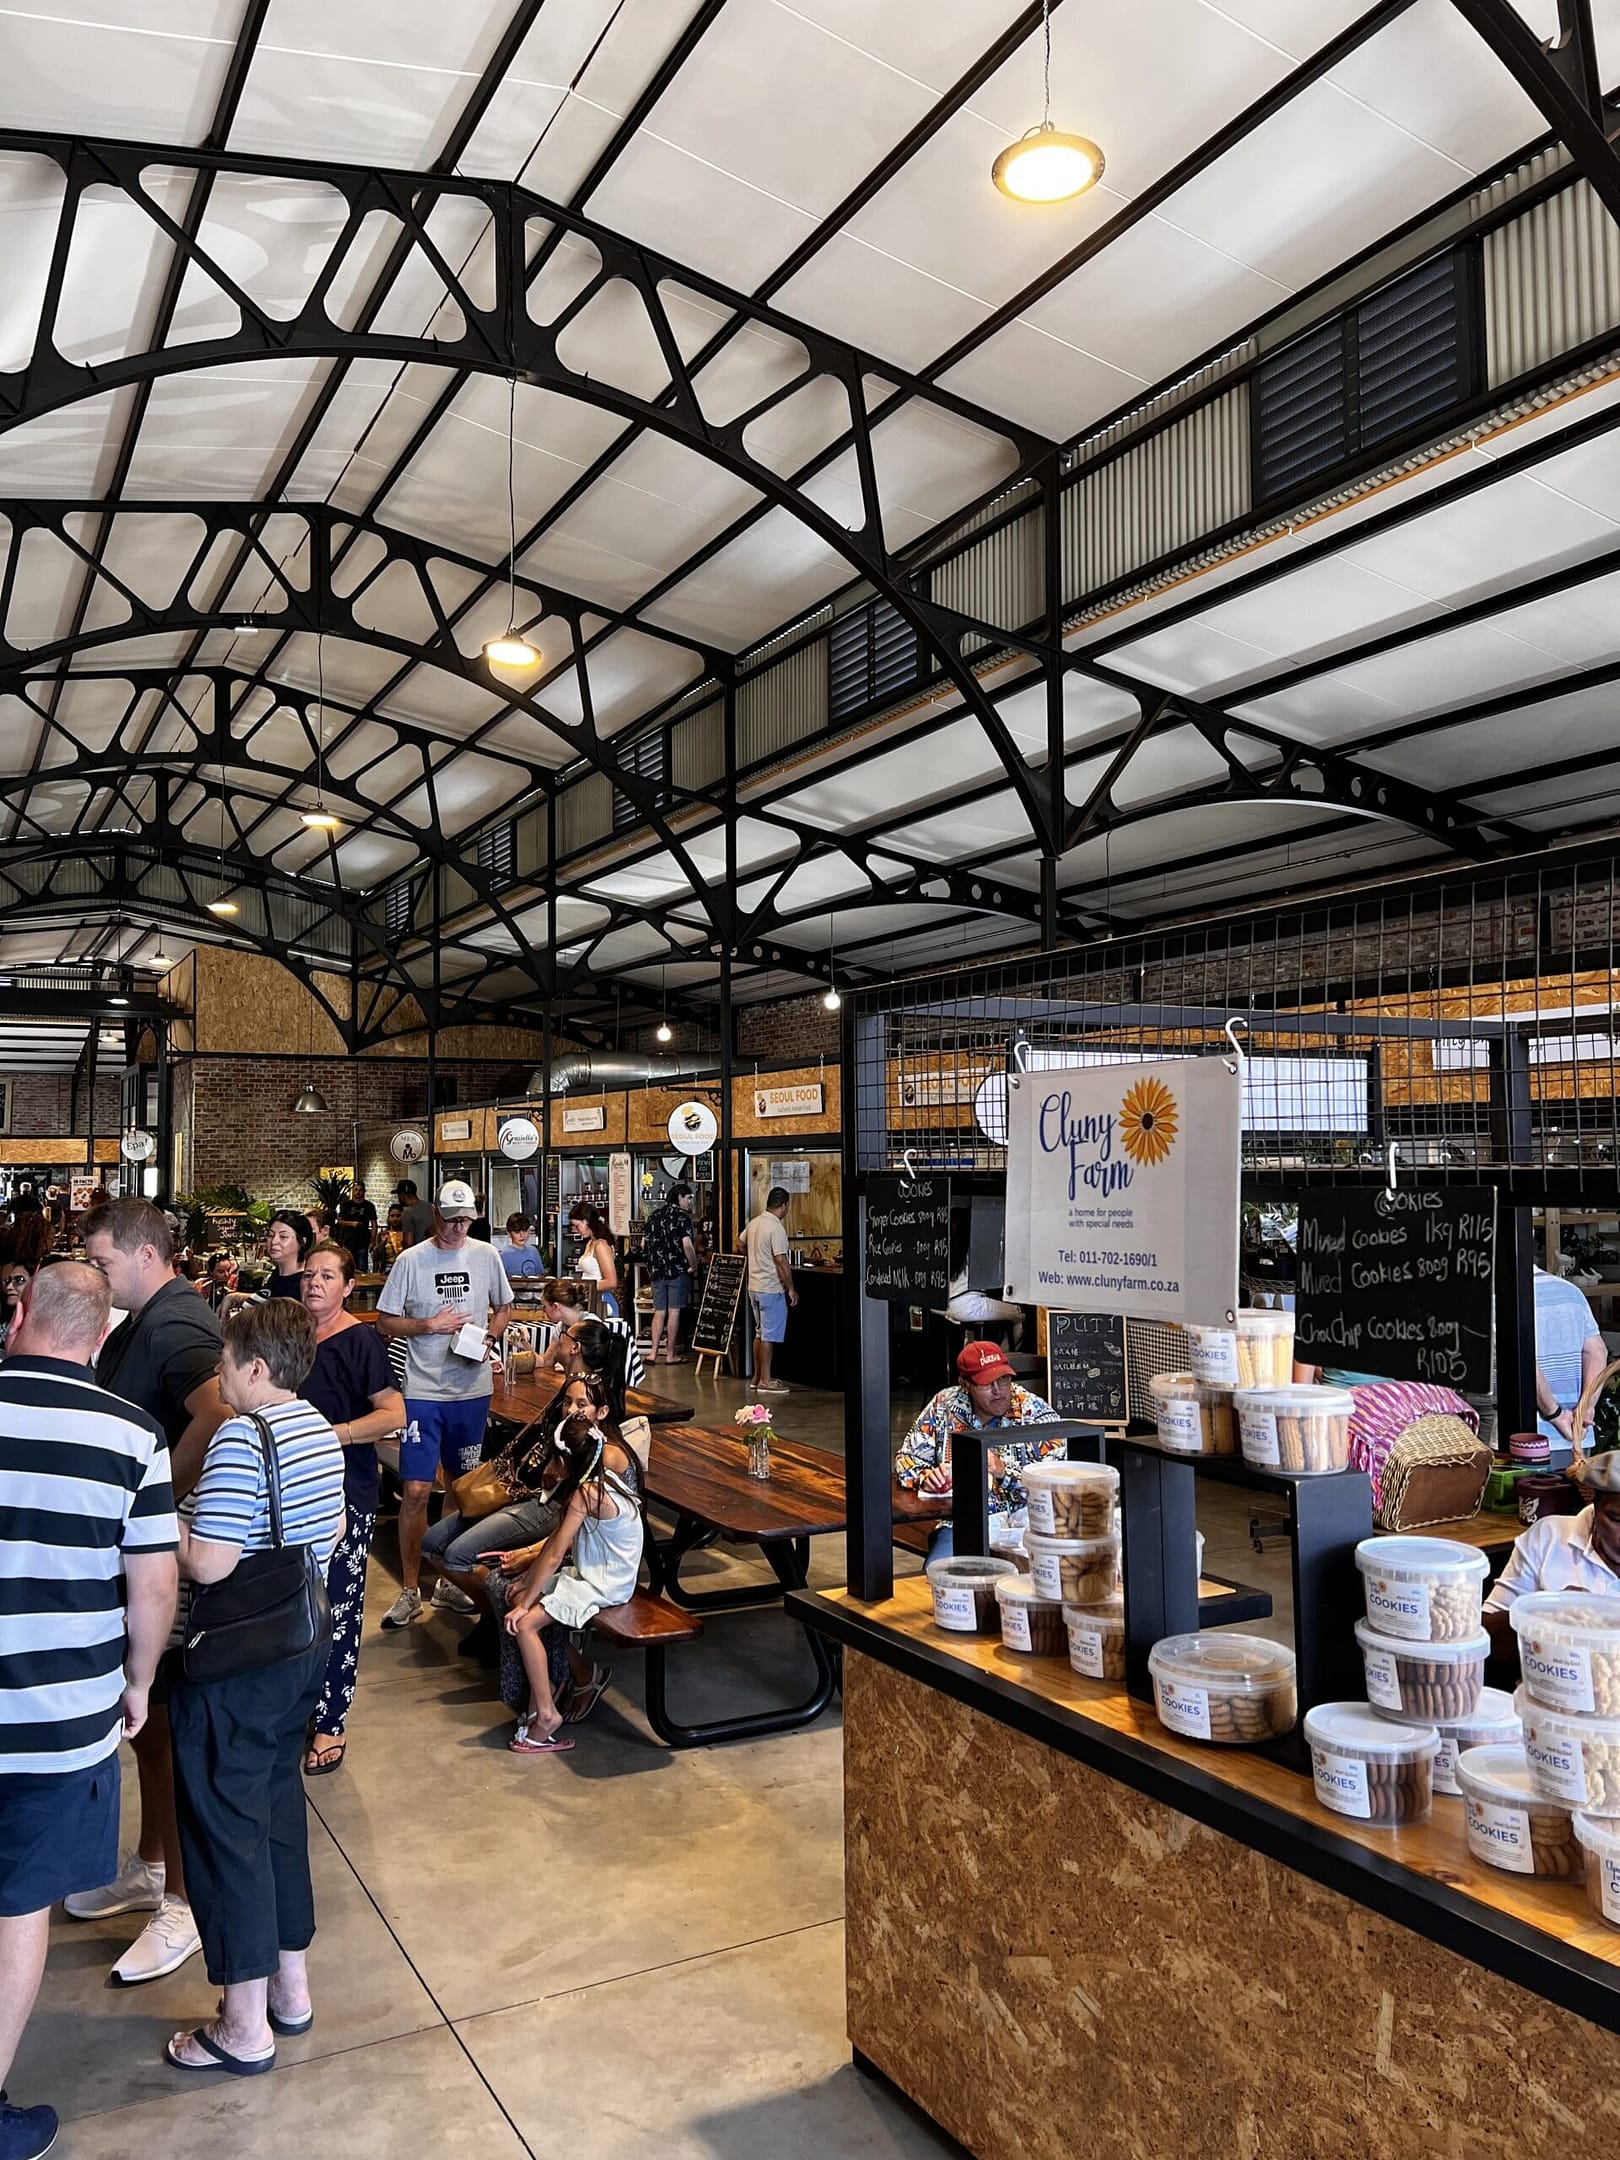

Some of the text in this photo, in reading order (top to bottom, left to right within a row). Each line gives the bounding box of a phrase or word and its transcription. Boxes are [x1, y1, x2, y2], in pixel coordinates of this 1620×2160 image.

[770, 1088, 818, 1104] SEOUL FOOD
[1039, 1091, 1117, 1162] Cluny
[1068, 1139, 1134, 1201] Farm
[1068, 1219, 1133, 1230] with special needs
[1074, 1208, 1095, 1217] home
[1096, 1207, 1107, 1217] for
[1108, 1208, 1133, 1221] people
[1459, 1213, 1493, 1243] R115
[1058, 1249, 1158, 1268] Tel: 011-702-1690/1
[1416, 1256, 1449, 1281] 800g
[1456, 1248, 1491, 1279] R95
[440, 1274, 465, 1284] Jeep
[1038, 1270, 1180, 1293] Web: www.clunyfarm.co.za
[1417, 1347, 1468, 1382] R105
[1370, 1593, 1418, 1614] COOKIES
[1524, 1655, 1578, 1681] COOKIES
[1161, 1695, 1201, 1715] COOKIES
[1527, 1744, 1570, 1770] OOKIES
[1468, 1816, 1518, 1844] COOKIES
